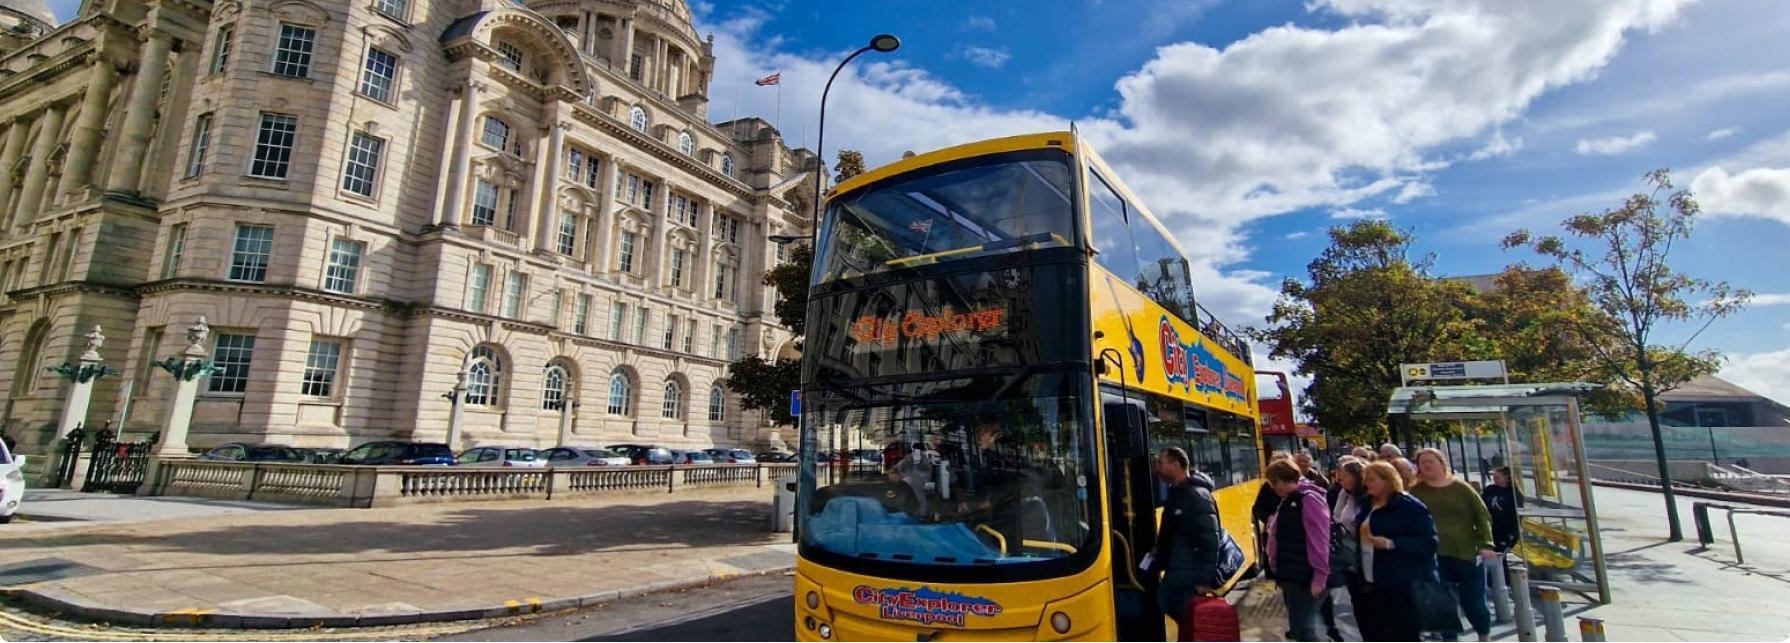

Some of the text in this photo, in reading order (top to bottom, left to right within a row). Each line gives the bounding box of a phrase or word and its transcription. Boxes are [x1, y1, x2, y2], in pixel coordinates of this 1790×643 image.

[853, 305, 1004, 346] City Explorer
[1159, 319, 1189, 389] City
[881, 605, 964, 626] Liverpool
